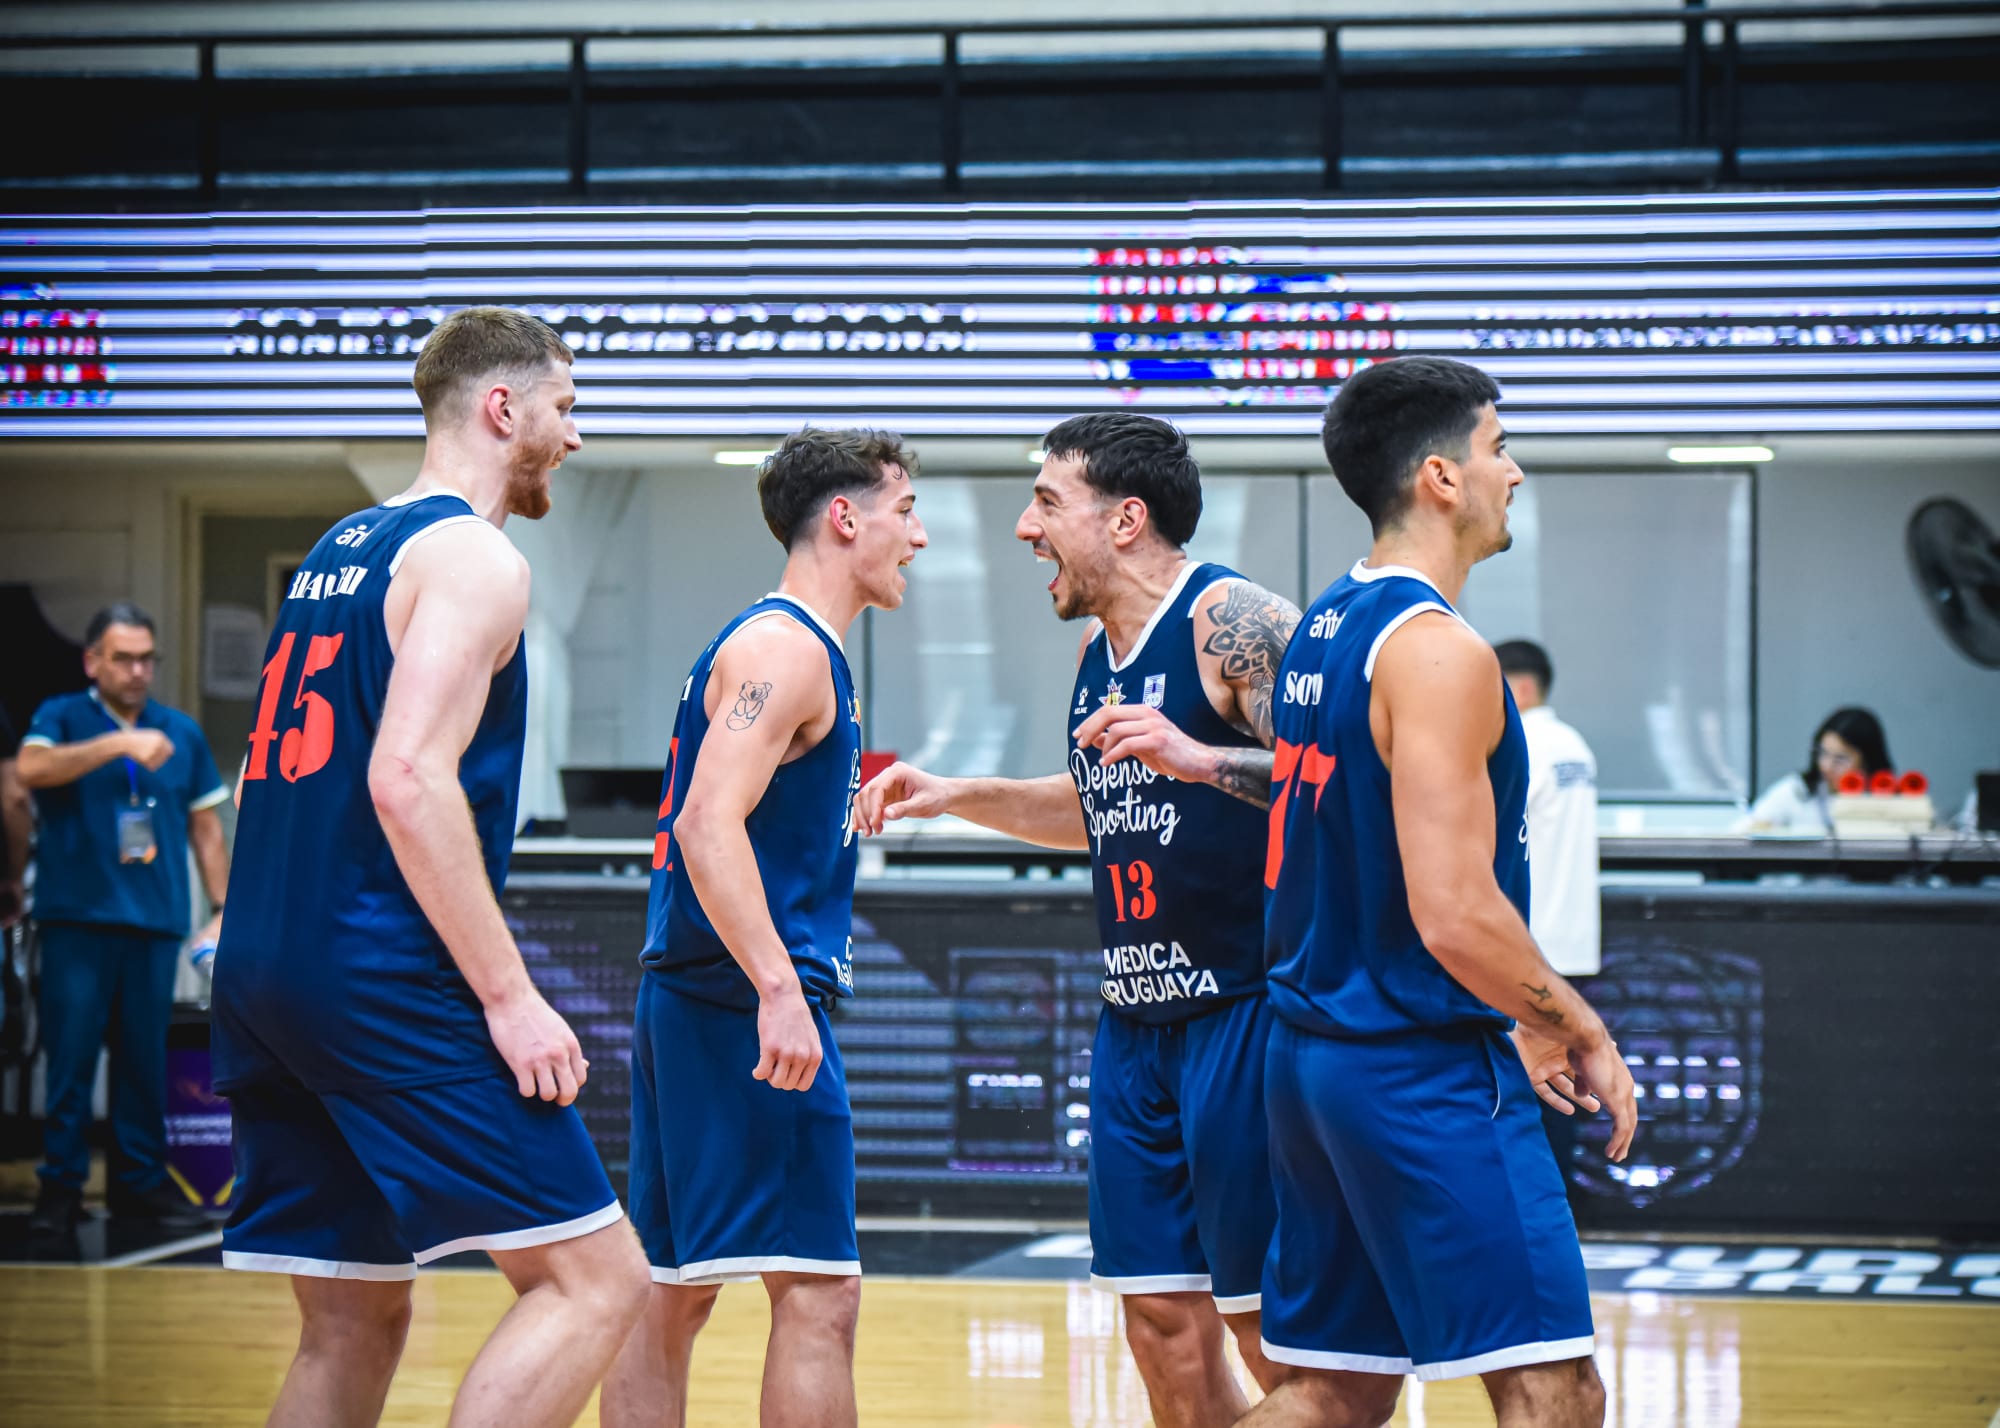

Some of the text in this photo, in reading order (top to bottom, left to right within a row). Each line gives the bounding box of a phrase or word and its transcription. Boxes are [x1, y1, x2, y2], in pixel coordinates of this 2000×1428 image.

[1071, 748, 1176, 800] Defenso
[1082, 787, 1181, 857] Sporting
[1107, 860, 1157, 922] 13
[1103, 940, 1192, 976] MEDICA
